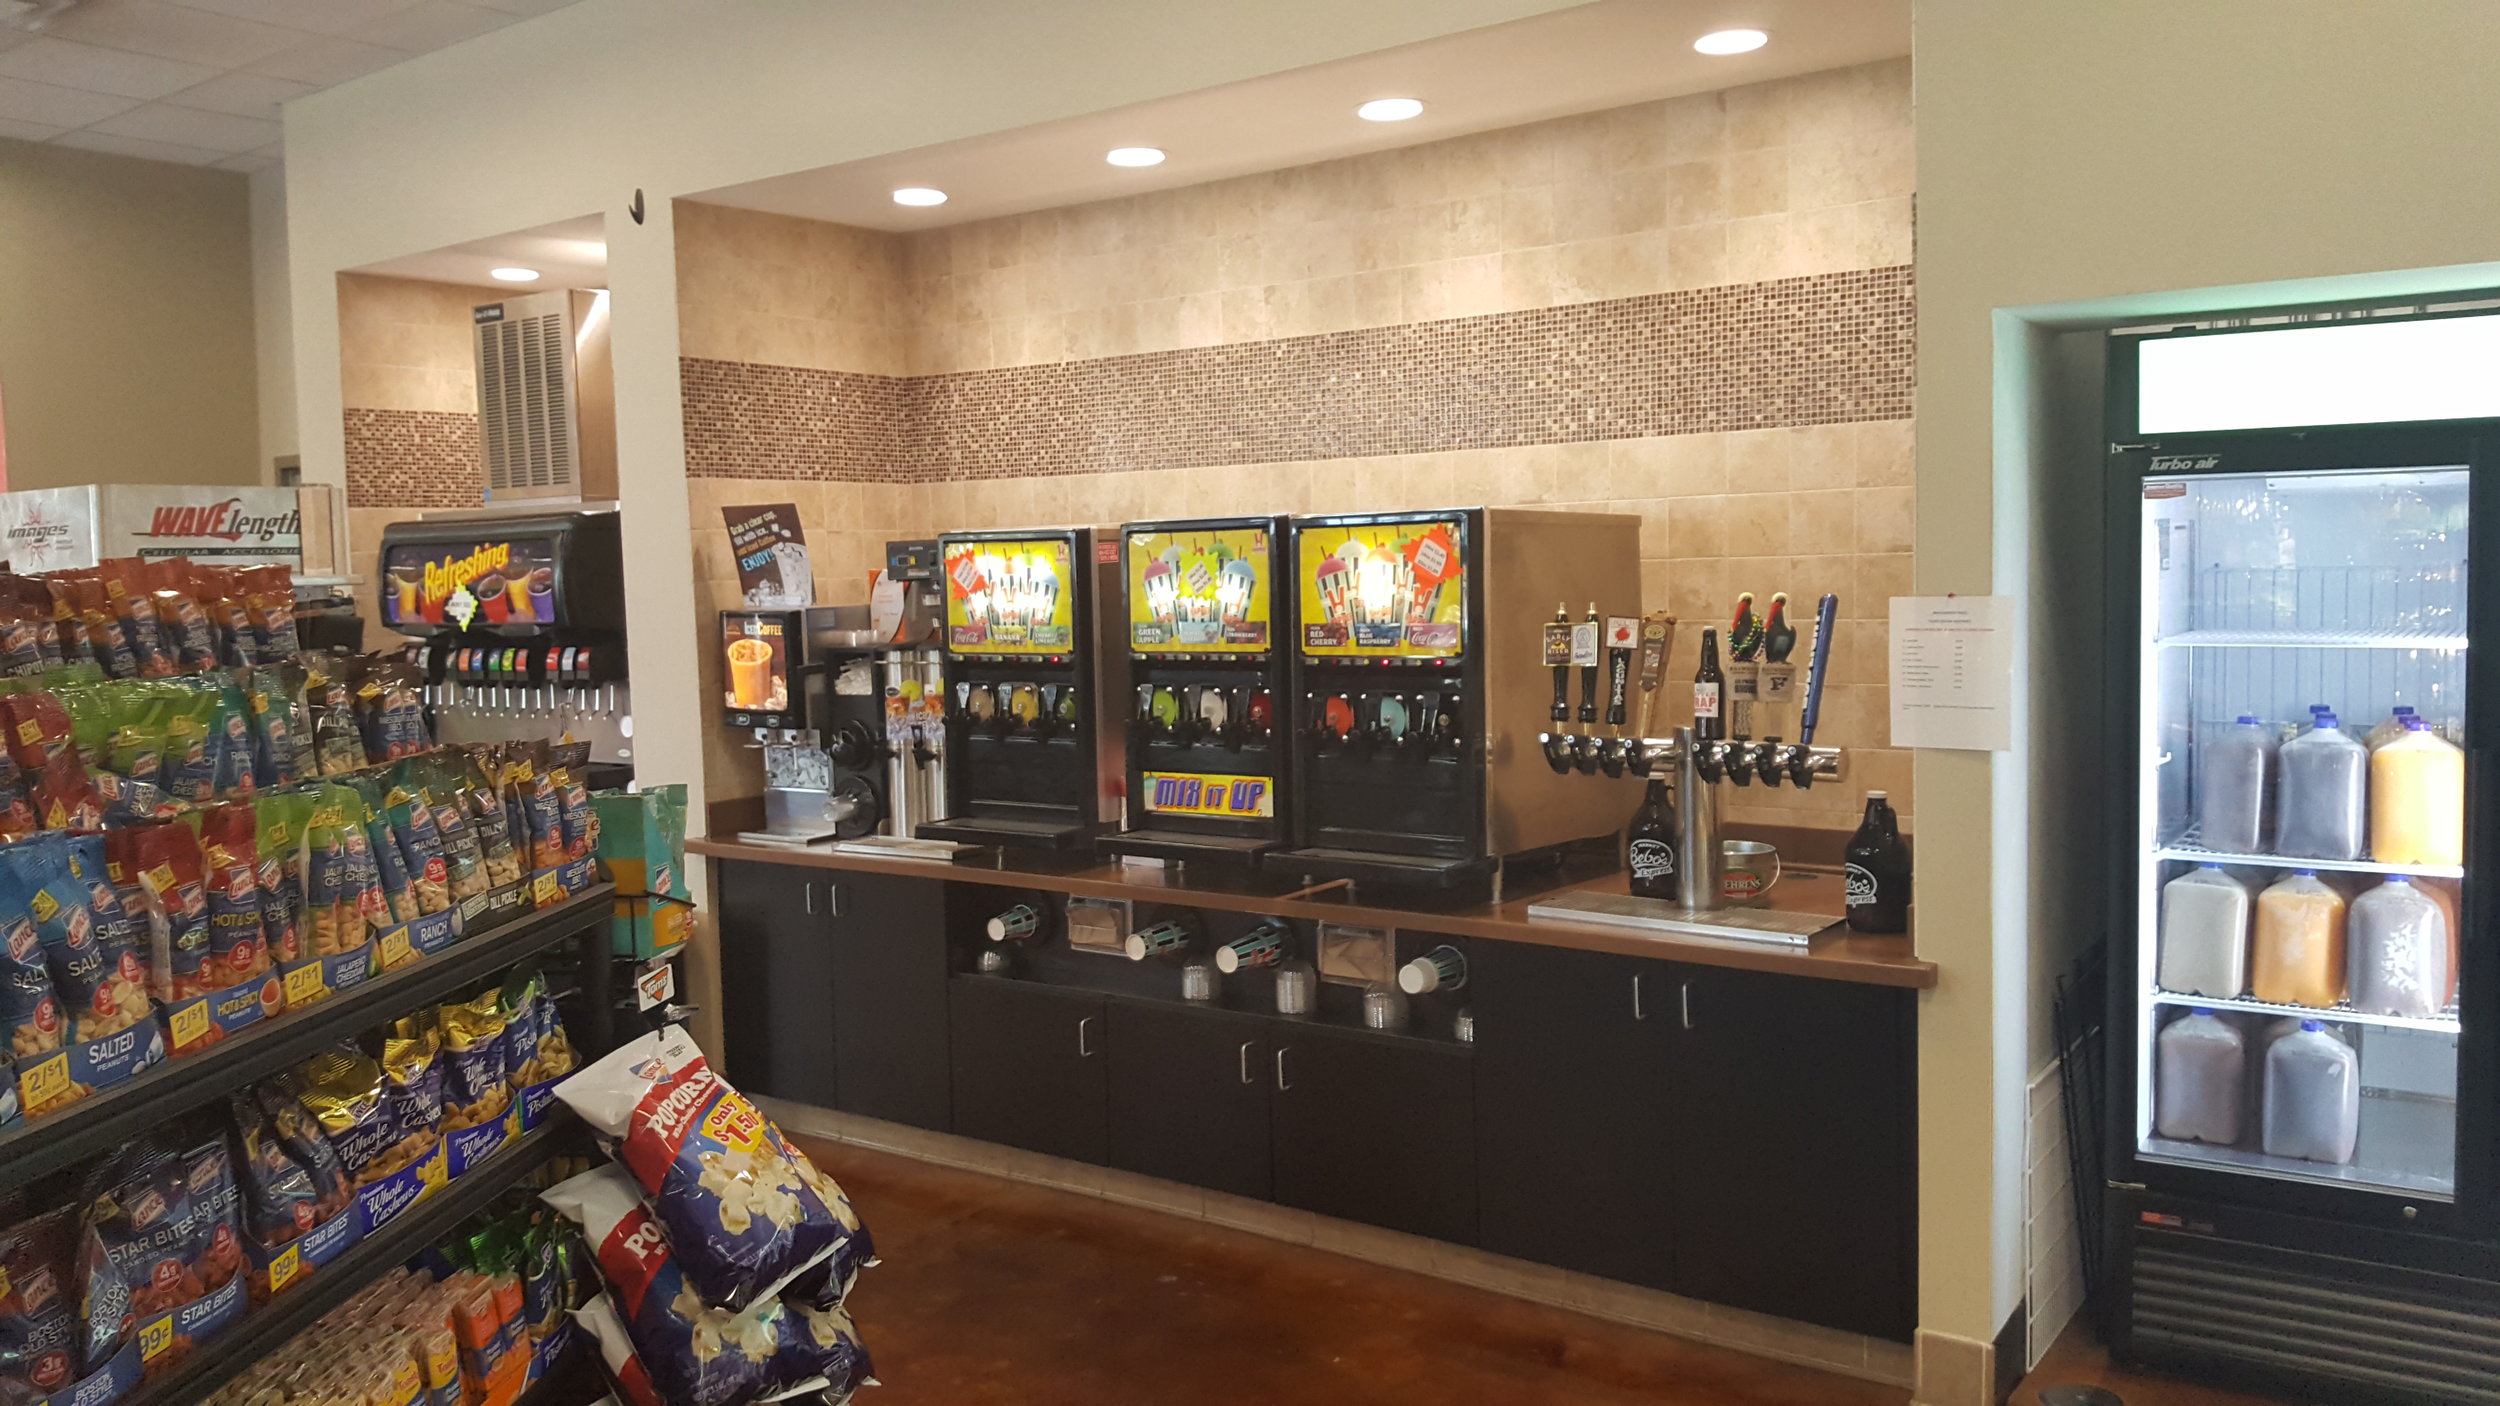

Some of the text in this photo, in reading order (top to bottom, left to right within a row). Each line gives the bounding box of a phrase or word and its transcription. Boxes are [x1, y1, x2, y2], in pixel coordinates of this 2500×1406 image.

[2149, 456, 2219, 471] Turbo air
[7, 525, 69, 543] images
[141, 548, 209, 556] CELLULAR
[741, 548, 776, 571] ENJOY!
[425, 542, 509, 606] Refreshing
[757, 621, 783, 635] COFFEE
[1138, 628, 1161, 636] GREEN
[1310, 638, 1337, 646] CHERRY
[1771, 677, 1788, 691] F
[1155, 778, 1265, 812] MIX IT UP
[420, 920, 448, 943] RANCH
[290, 966, 318, 991] 2/$1
[335, 966, 366, 984] CHEDDAR
[176, 1004, 204, 1034] 2/$1
[89, 1031, 134, 1065] SALTED
[28, 1057, 65, 1092] 2/$1
[97, 1054, 130, 1073] PEANUTS
[648, 1065, 713, 1140] POPCORN
[710, 1100, 738, 1126] Only
[339, 1123, 388, 1160] Whole
[713, 1111, 760, 1145] $1.50
[461, 1128, 494, 1158] Whole
[359, 1182, 386, 1202] Premium
[367, 1178, 404, 1214] Whole
[372, 1184, 416, 1228] Cashews
[109, 1217, 196, 1264] STAR BITES
[304, 1216, 349, 1252] STAR BITES
[181, 1281, 237, 1325] STAR BITES
